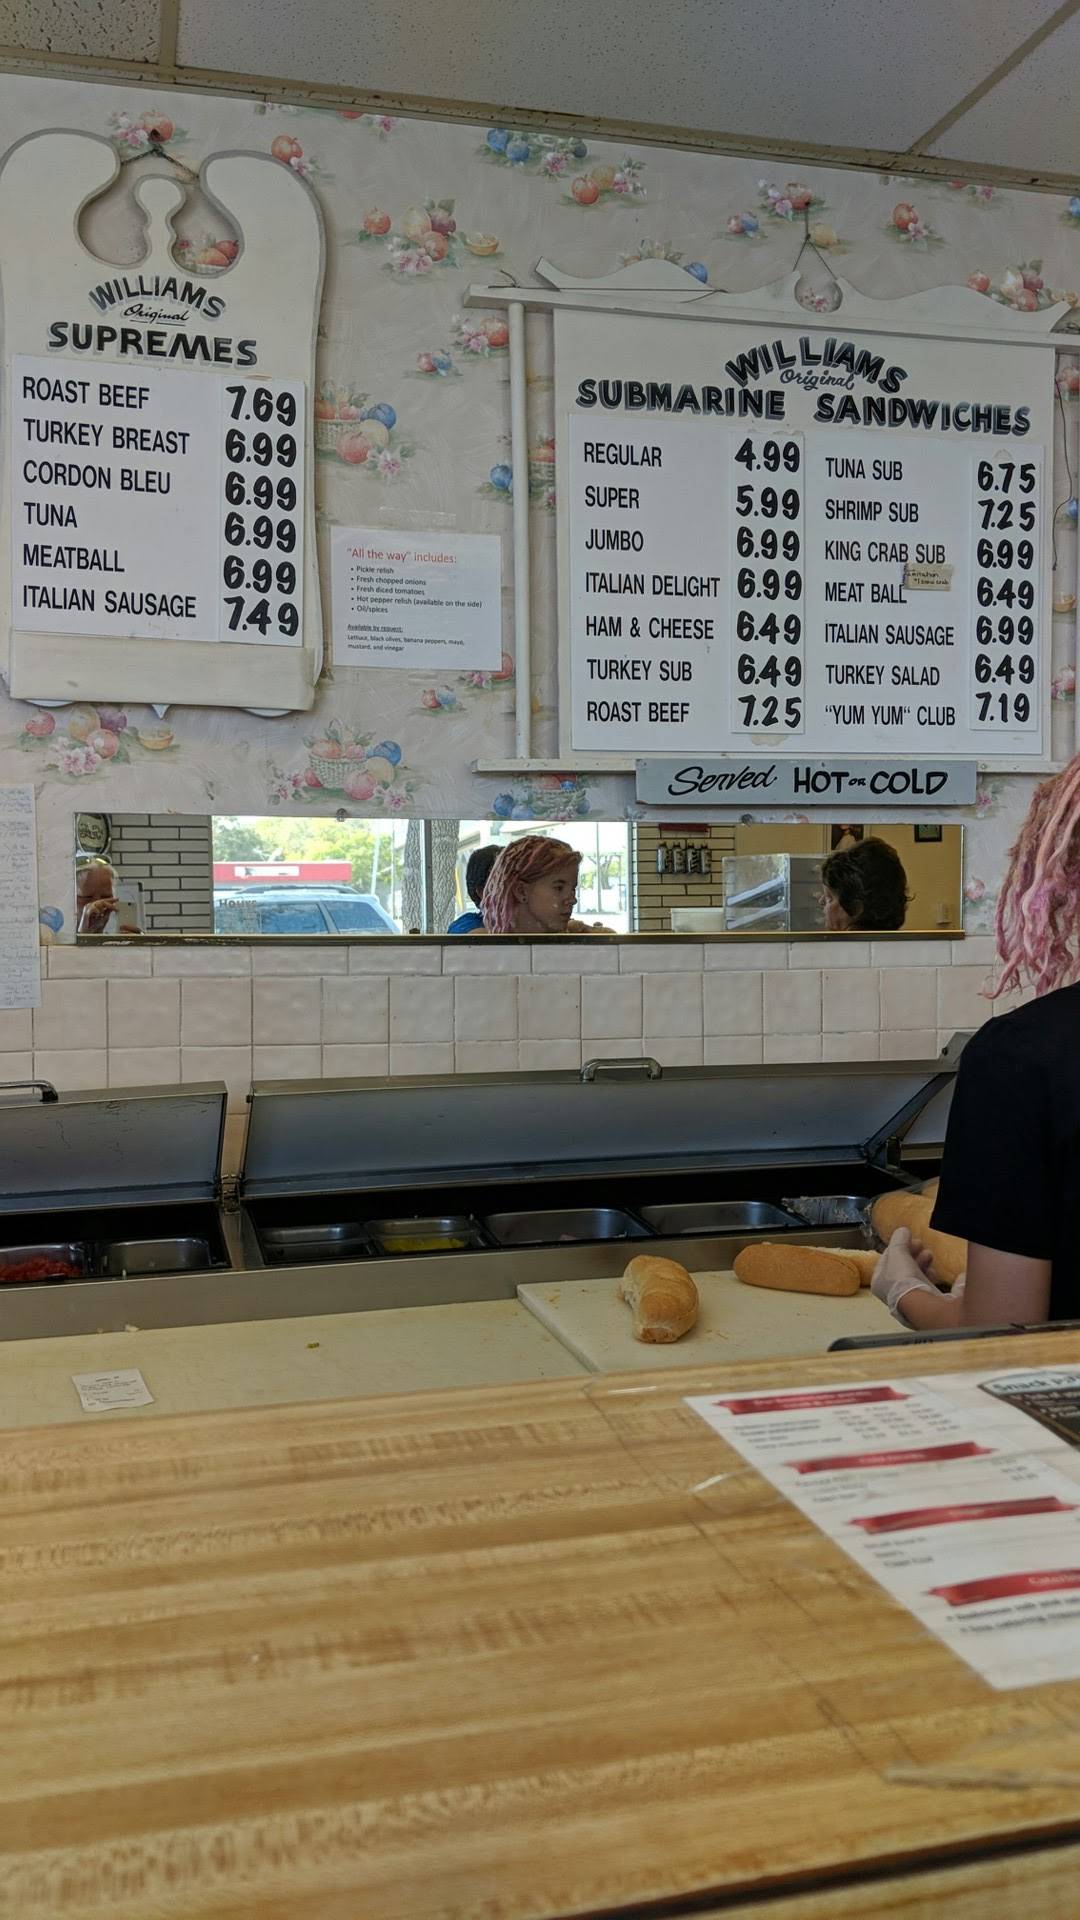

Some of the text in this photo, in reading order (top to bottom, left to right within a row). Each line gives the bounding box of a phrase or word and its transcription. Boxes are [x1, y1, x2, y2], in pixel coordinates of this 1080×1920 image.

[88, 275, 226, 320] WILLIAMS
[124, 303, 190, 325] Original
[47, 322, 258, 368] SUPREMES
[725, 336, 909, 394] WILLIAMS
[780, 369, 855, 392] Original
[22, 377, 150, 409] ROAST BEEF
[226, 386, 296, 426] 7.69
[575, 379, 1031, 436] SUBMARINE SANDWICHES
[24, 419, 190, 454] TURKEY BREAST
[225, 428, 296, 467] 6.99
[583, 442, 662, 467] REGULAR
[735, 437, 800, 473] 4.99
[826, 457, 903, 481] TUNA SUB
[23, 461, 171, 494] CORDON BLEU
[225, 472, 296, 511] 6.99
[977, 460, 1036, 494] 6.75
[585, 486, 639, 509] SUPER
[736, 485, 800, 520] 5.99
[826, 499, 919, 522] SHRIMP SUB
[24, 502, 77, 527] TUNA
[978, 499, 1035, 532] 7.25
[224, 512, 295, 553] 6.99
[585, 529, 644, 551] JUMBO
[736, 529, 801, 562] 6.99
[23, 544, 125, 572] MEATBALL
[368, 550, 383, 559] the
[414, 552, 457, 563] includes:
[825, 541, 946, 564] KING CRAB SUB
[977, 538, 1034, 569] 6.99
[224, 555, 296, 594] 6.99
[376, 577, 403, 585] chopped
[585, 572, 720, 597] ITALIAN DELIGHT
[737, 568, 802, 601] 6.99
[23, 585, 196, 618] ITALIAN SAUSAGE
[467, 600, 482, 608] side)
[825, 582, 907, 604] MEAT BALL
[977, 578, 1034, 610] 6.49
[224, 596, 298, 636] 7.49
[586, 616, 714, 640] HAM & CHEESE
[736, 611, 802, 645] 6.49
[976, 615, 1034, 645] 6.99
[825, 623, 954, 646] ITALIAN SAUSAGE
[587, 659, 692, 682] TURKEY SUB
[738, 654, 802, 687] 6.49
[826, 665, 940, 685] TURKEY SALAD
[975, 654, 1034, 685] 6.49
[587, 702, 690, 722] ROAST BEEF
[738, 695, 801, 728] 7.25
[917, 706, 955, 726] CLUB
[976, 691, 1030, 722] 7.19
[668, 765, 778, 797] Served
[794, 767, 848, 794] HOT
[870, 771, 948, 795] COLD
